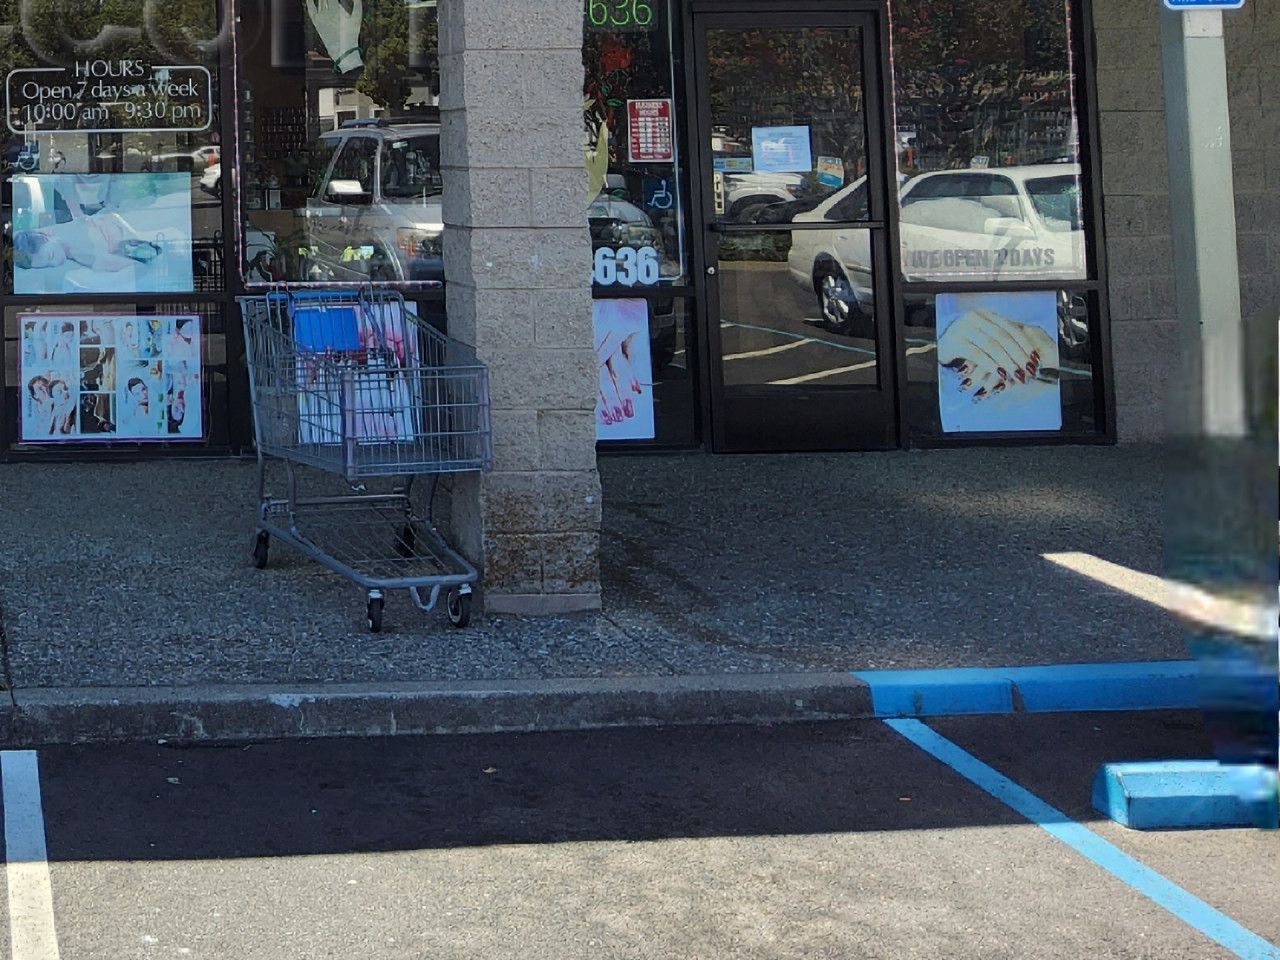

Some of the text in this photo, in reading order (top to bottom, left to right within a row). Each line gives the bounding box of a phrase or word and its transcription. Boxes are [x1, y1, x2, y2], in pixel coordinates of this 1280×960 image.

[75, 60, 145, 77] HOURS
[23, 81, 72, 104] Open
[77, 81, 87, 99] 7
[91, 80, 131, 102] days
[152, 78, 199, 98] week
[25, 102, 200, 123] 10:00 am 9:30 pm
[592, 246, 659, 286] 636
[912, 249, 941, 268] WE
[944, 248, 988, 267] OPEN
[1011, 248, 1055, 267] DAYS
